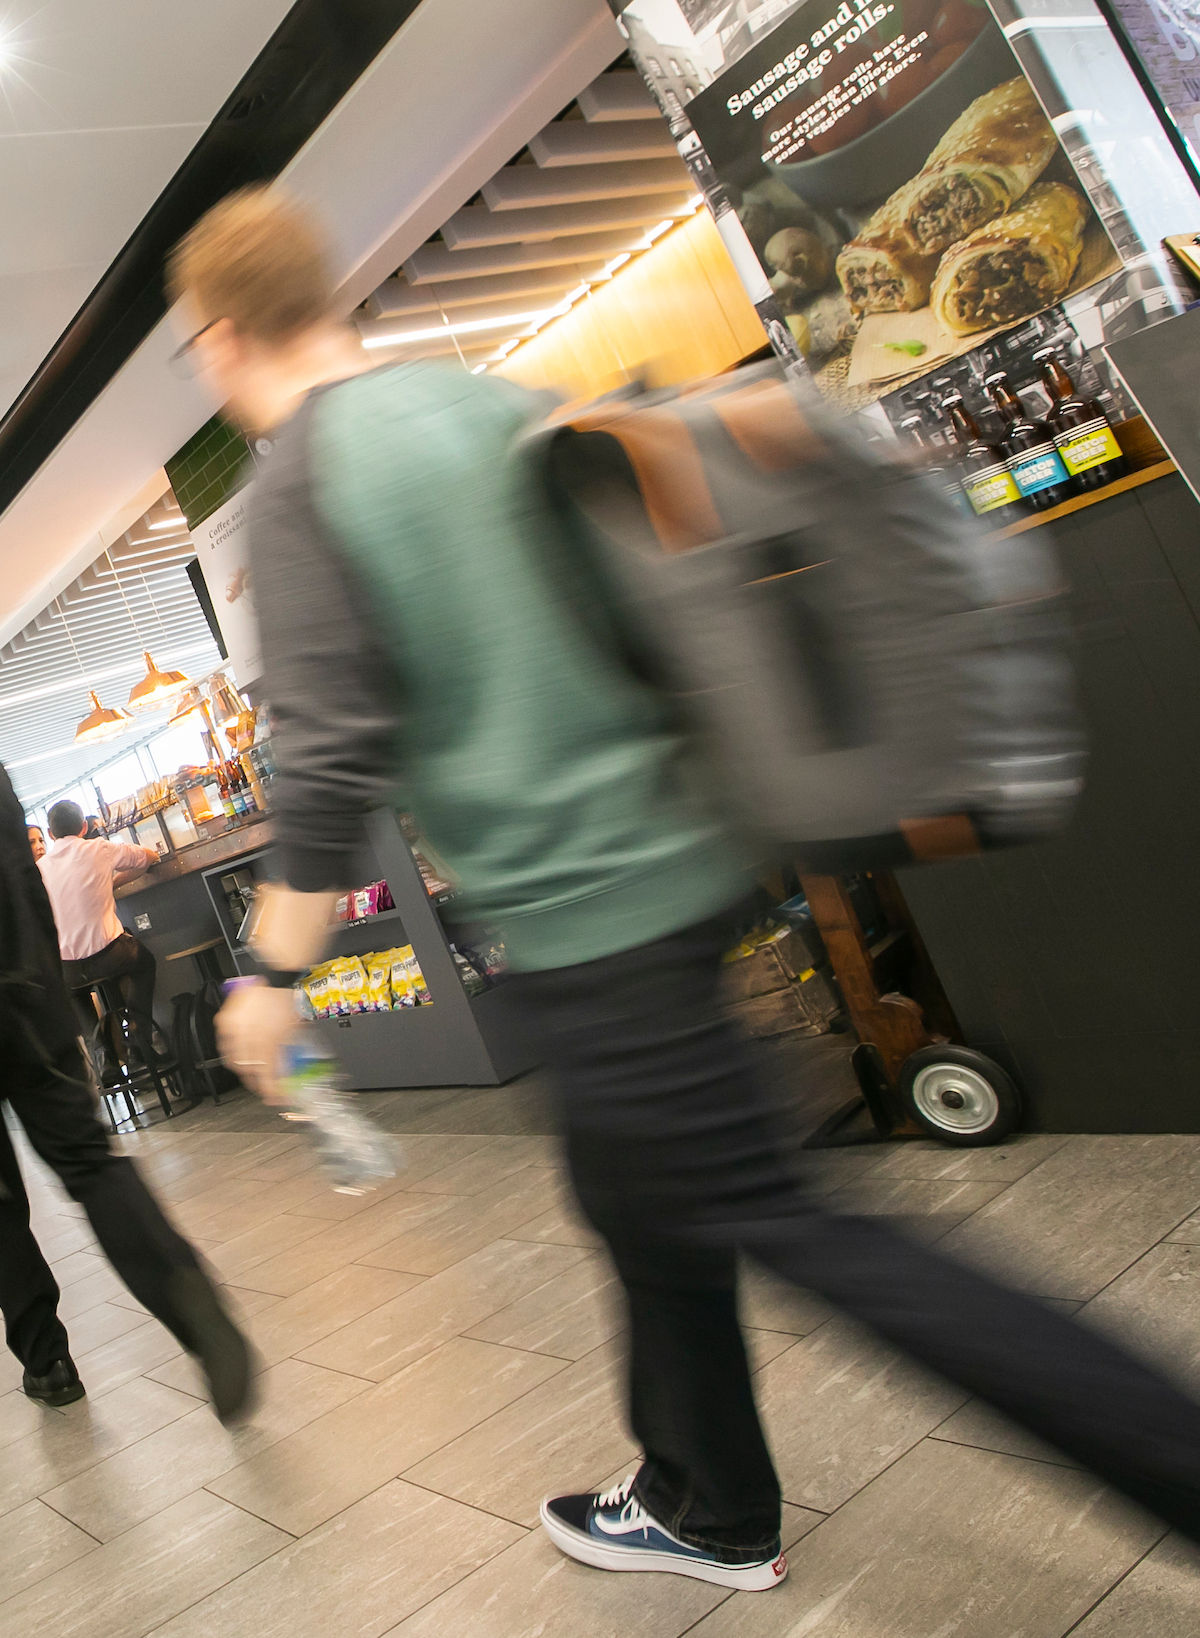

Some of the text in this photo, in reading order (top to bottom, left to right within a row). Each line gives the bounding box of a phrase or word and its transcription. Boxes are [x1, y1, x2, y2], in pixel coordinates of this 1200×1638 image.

[726, 43, 809, 117] Sausage
[810, 1, 854, 48] and
[751, 49, 833, 120] sausage
[833, 3, 895, 53] rolls.
[761, 31, 929, 163] more styles than Dior. Even
[769, 34, 906, 143] Our sausage rolls have
[774, 53, 922, 165] some veggies will adore.
[1021, 468, 1054, 486] CIDER
[1070, 444, 1107, 464] CIDER
[208, 504, 245, 539] Coffee and
